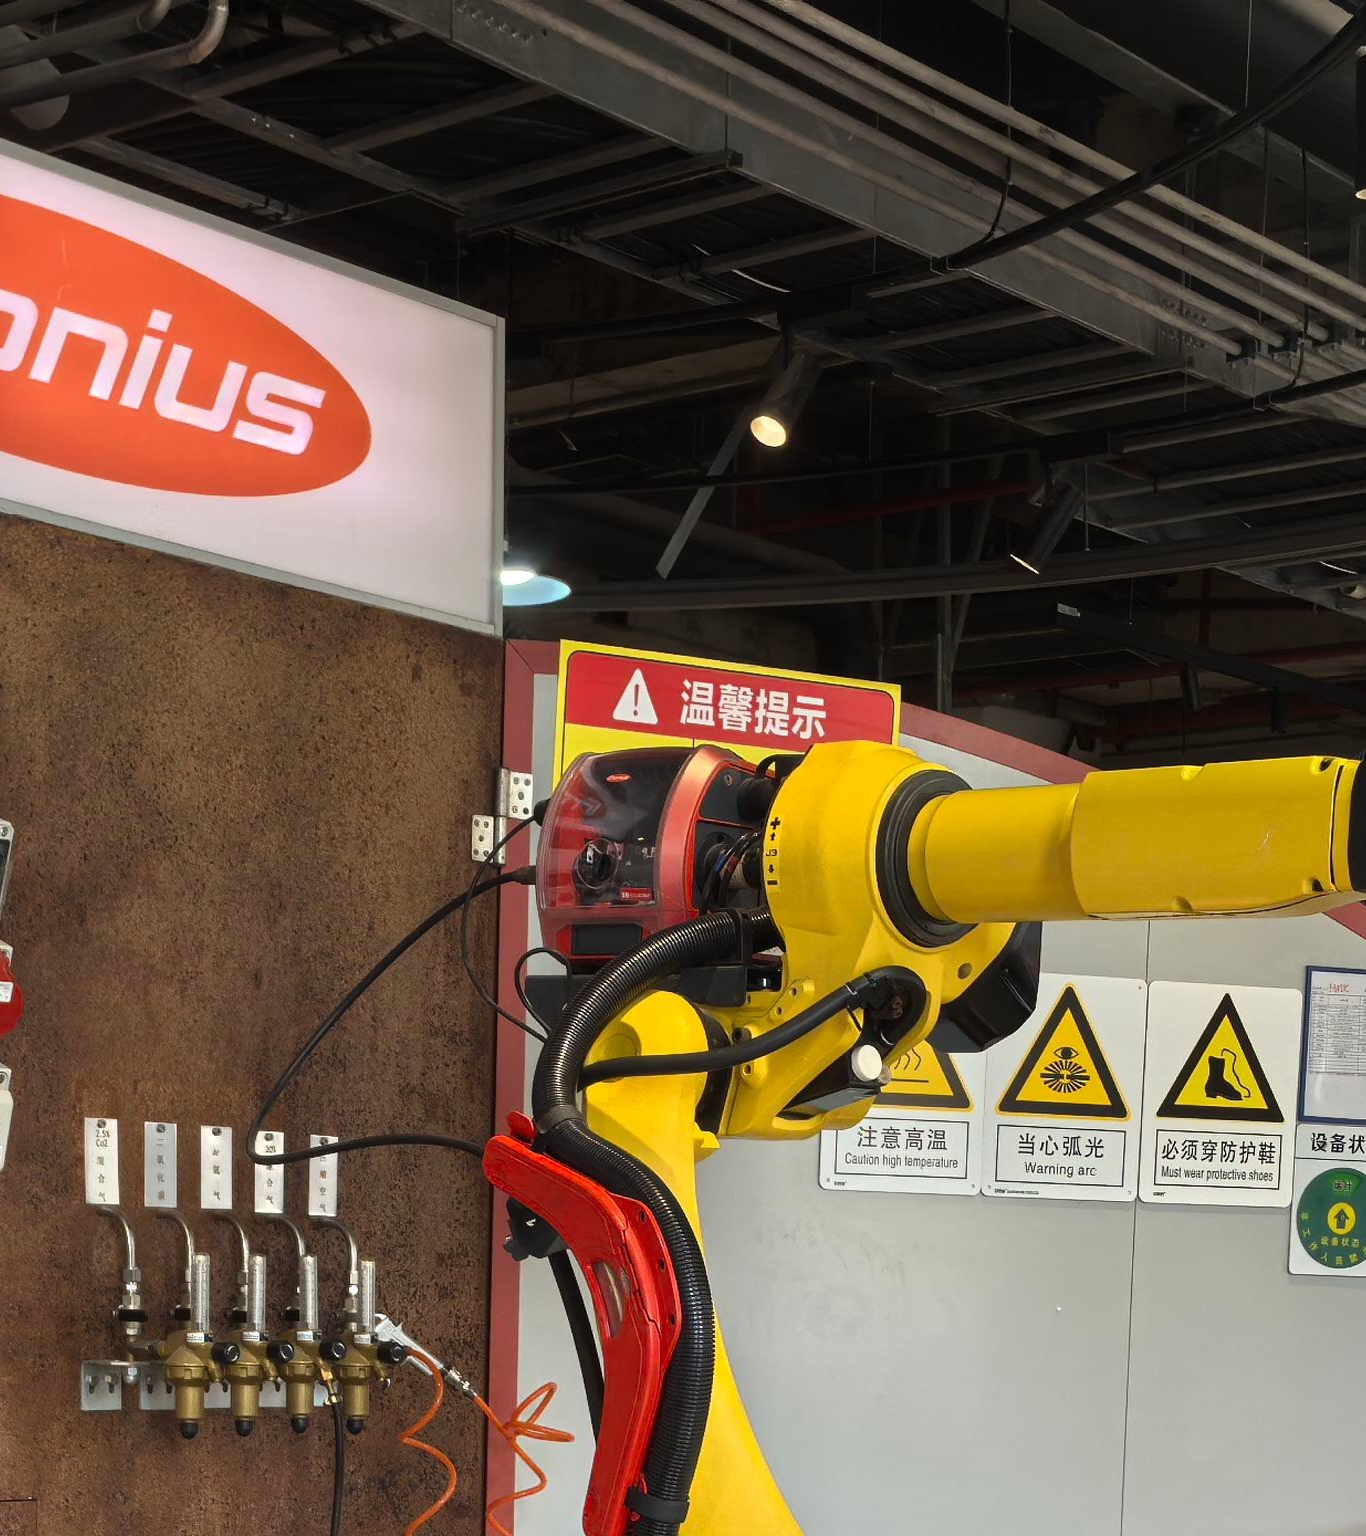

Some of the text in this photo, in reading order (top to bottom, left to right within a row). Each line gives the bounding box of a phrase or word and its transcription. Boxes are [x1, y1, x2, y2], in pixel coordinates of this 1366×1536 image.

[680, 678, 826, 739] 温馨提示
[857, 1125, 948, 1151] 注意高温
[1018, 1132, 1105, 1159] 当心弧光
[845, 1151, 959, 1170] Caution high temperature
[1161, 1138, 1276, 1165] 必须穿防护鞋
[1024, 1161, 1098, 1178] Warning arc
[1161, 1165, 1274, 1182] Must wear protective shoes
